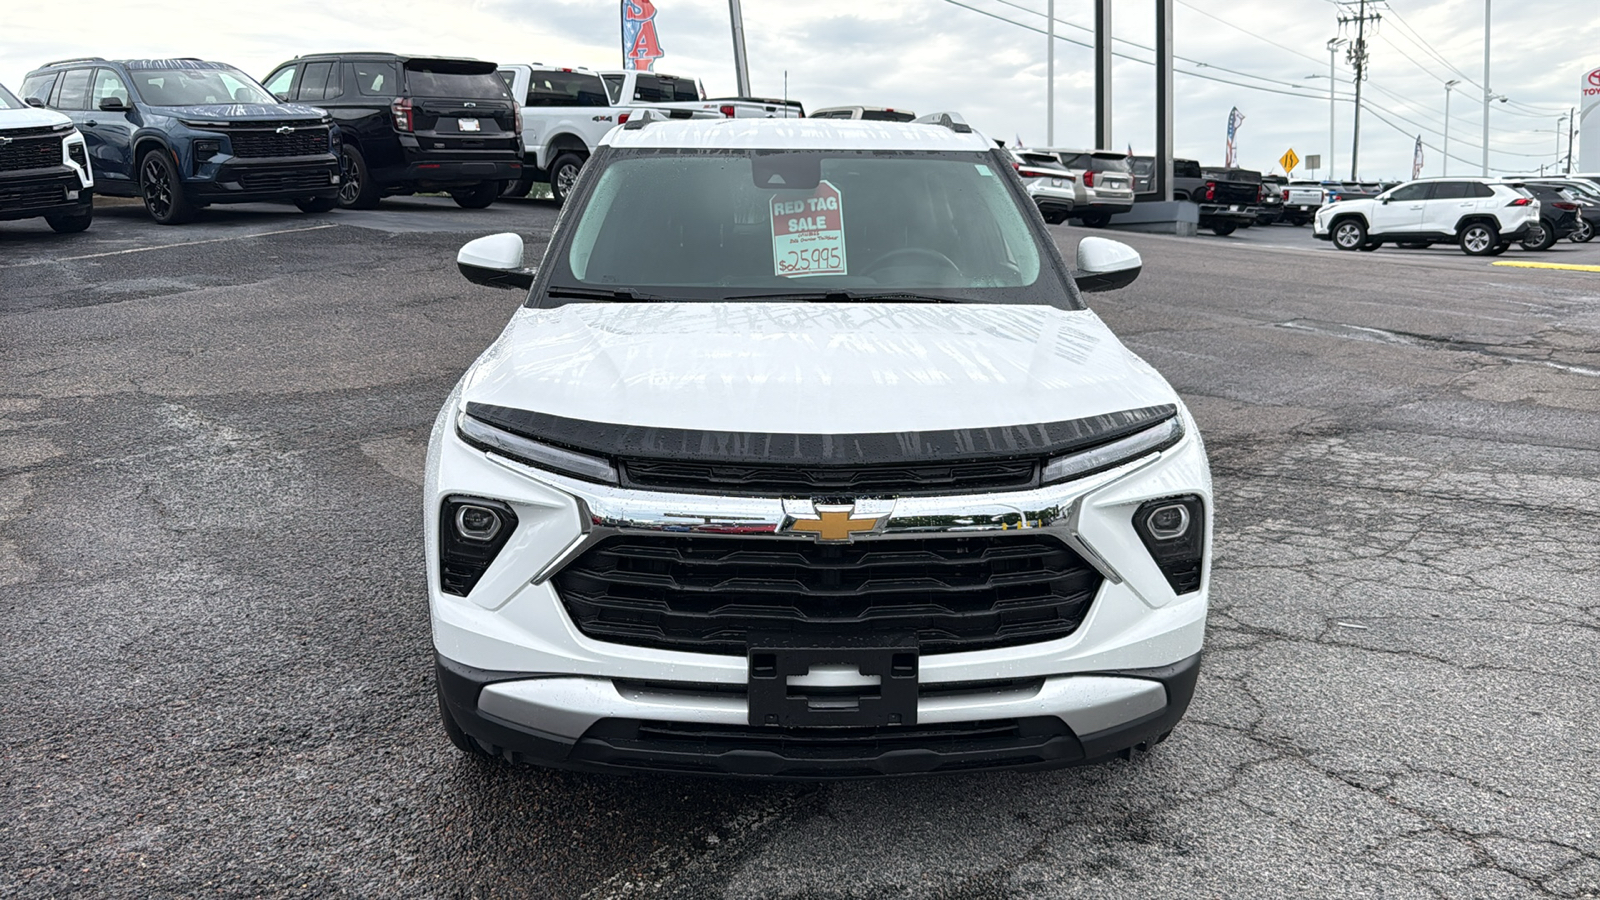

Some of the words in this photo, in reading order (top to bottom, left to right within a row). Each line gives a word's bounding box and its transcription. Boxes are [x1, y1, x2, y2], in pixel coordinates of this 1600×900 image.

[774, 200, 805, 216] RED
[807, 196, 838, 212] TAG
[788, 216, 827, 232] SALE
